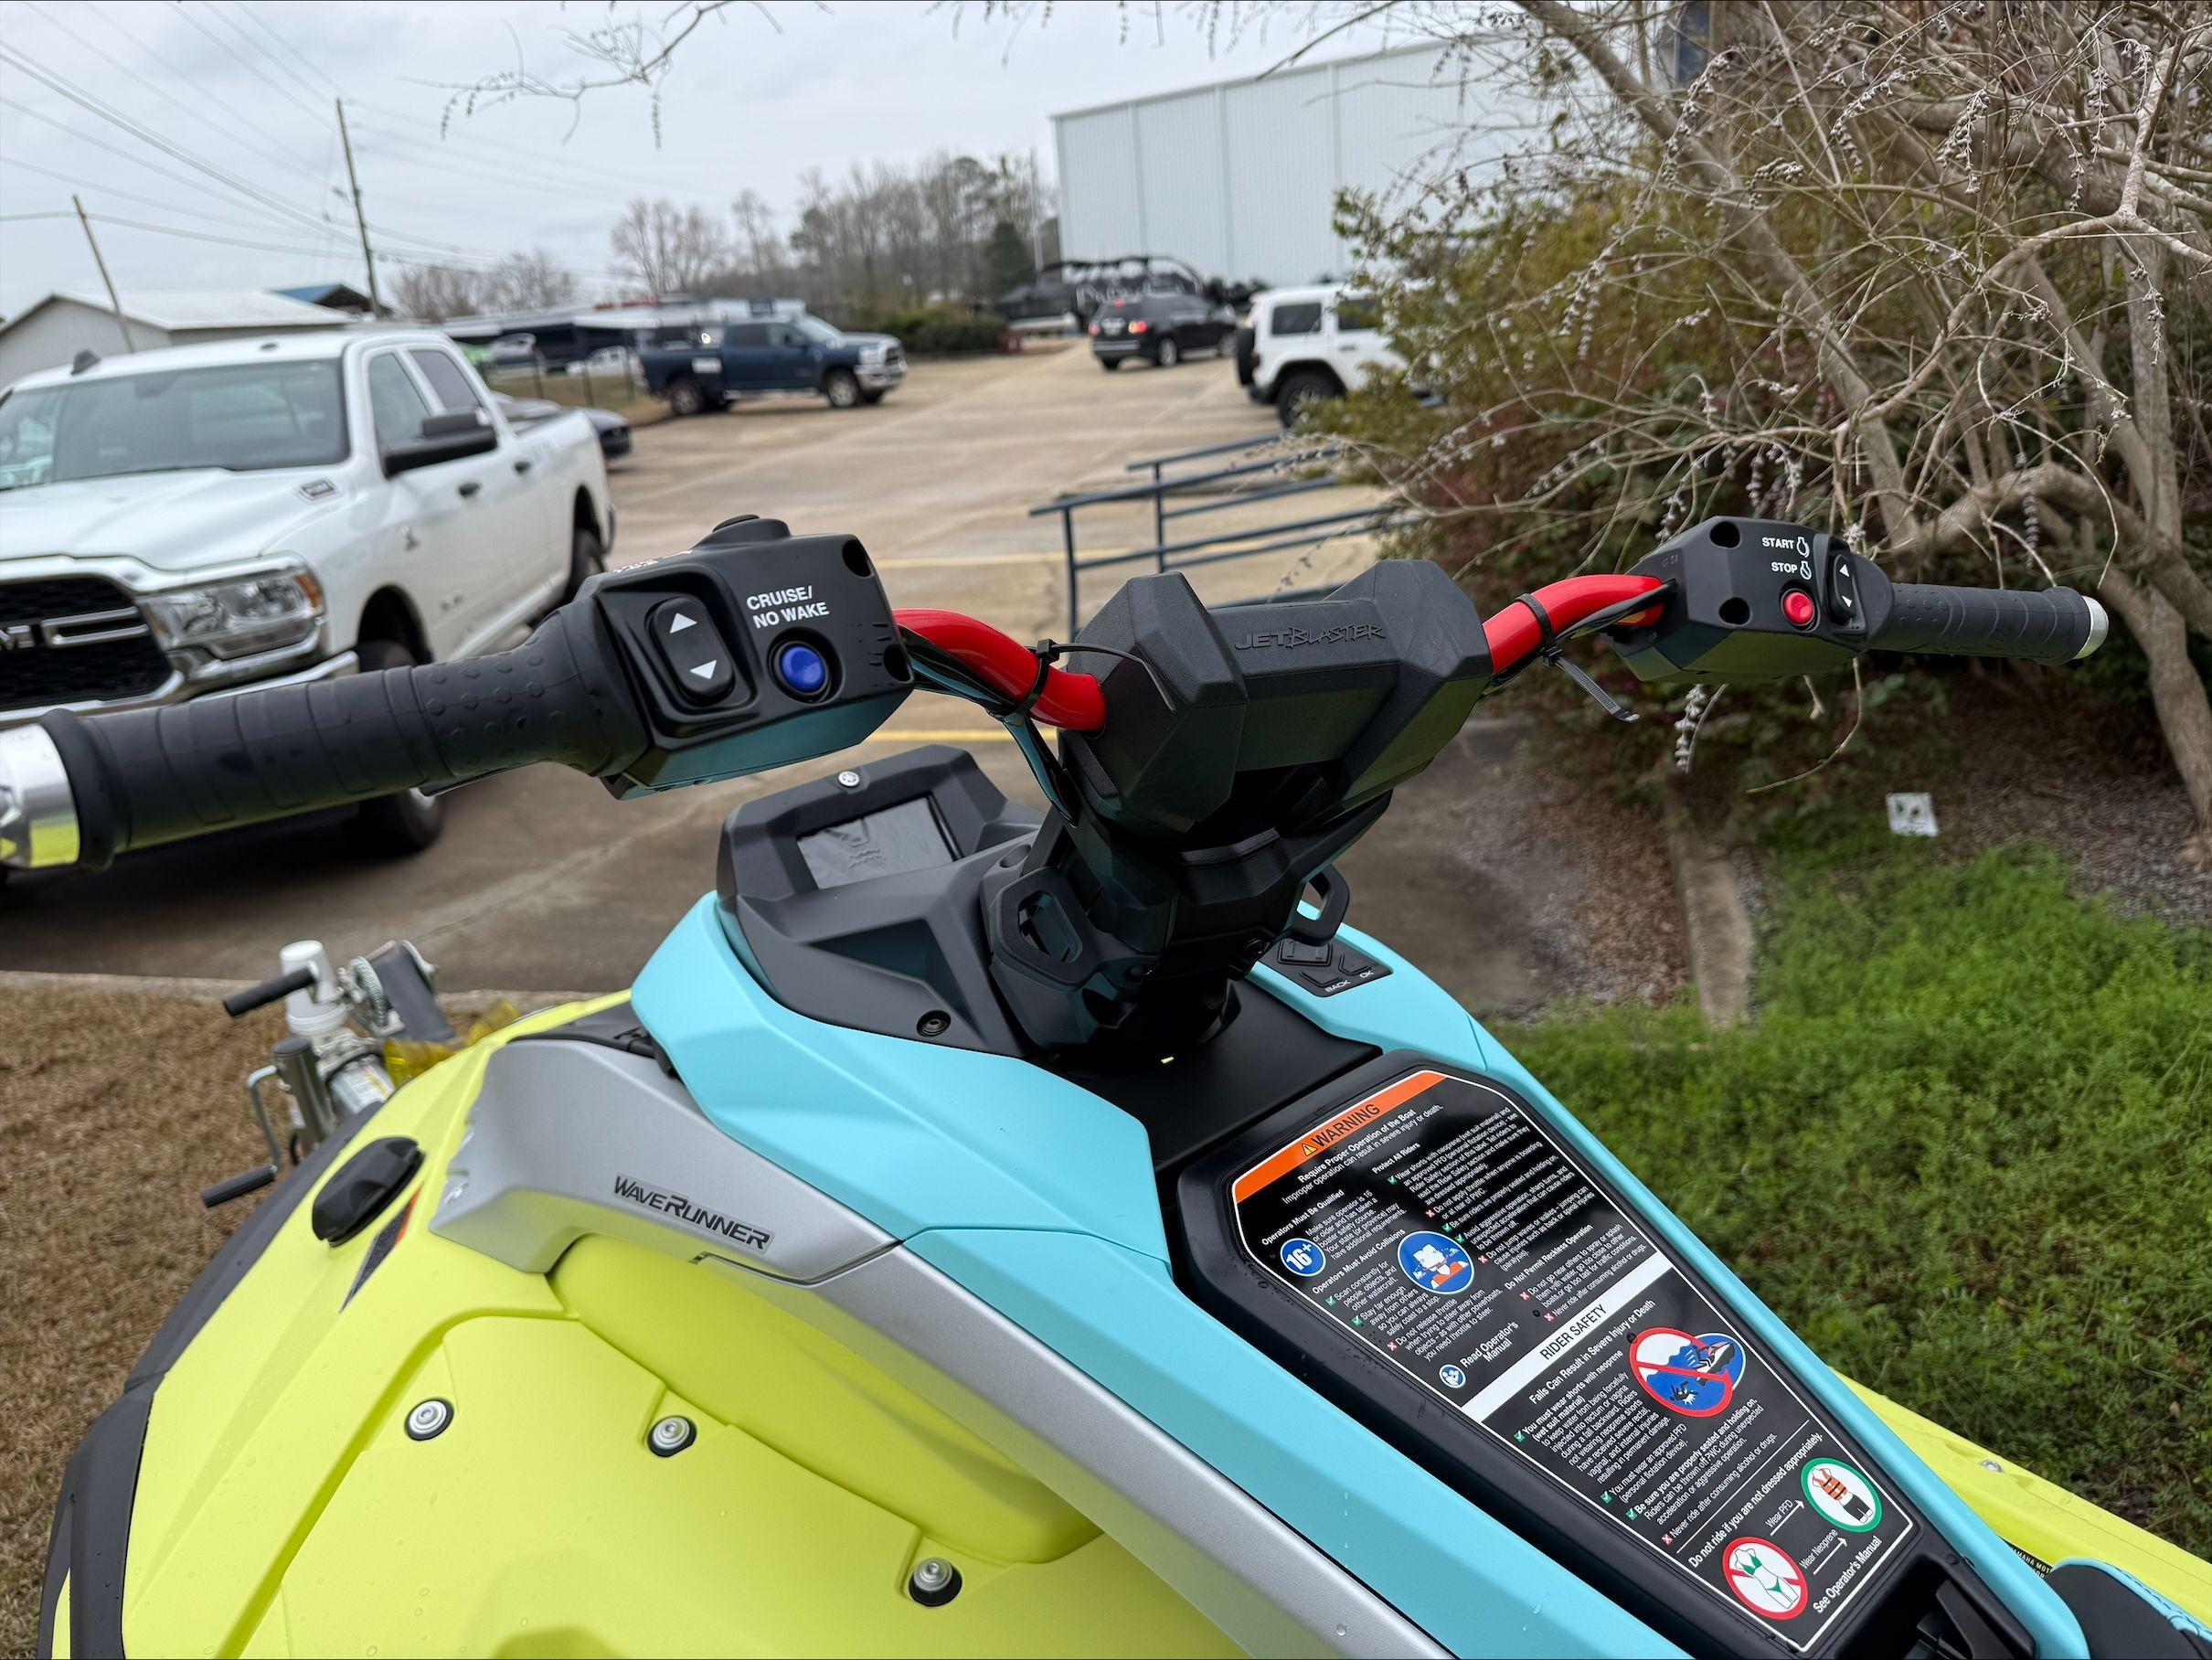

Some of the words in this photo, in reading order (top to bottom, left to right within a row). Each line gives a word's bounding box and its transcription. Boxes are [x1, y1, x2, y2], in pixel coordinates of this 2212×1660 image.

[1762, 537, 1794, 550] START
[1771, 562, 1797, 574] STOP
[746, 585, 813, 611] CRUISE/
[752, 611, 780, 629] NO
[781, 602, 830, 623] WAKE
[1324, 979, 1351, 993] BACK
[1359, 970, 1374, 979] OK
[1297, 1164, 1326, 1182] Require
[1324, 1148, 1349, 1165] Proper
[1347, 1130, 1382, 1151] Operation
[1380, 1123, 1389, 1132] of
[1387, 1119, 1400, 1128] the
[1397, 1109, 1416, 1121] Boat
[1310, 1103, 1380, 1146] WARNING
[1281, 1182, 1313, 1204] Improper
[1313, 1163, 1345, 1185] operation
[1343, 1155, 1357, 1165] can
[1355, 1144, 1374, 1158] result
[1379, 1129, 1400, 1144] severe
[1398, 1119, 1418, 1131] injury
[1422, 1104, 1443, 1117] death.
[1371, 1157, 1395, 1174] Protect
[1392, 1152, 1402, 1161] All
[1399, 1143, 1420, 1155] Riders
[1261, 1222, 1293, 1245] Operators
[1291, 1211, 1310, 1225] Must
[1306, 1207, 1318, 1215] Be
[1316, 1188, 1344, 1208] Qualified
[1304, 1223, 1324, 1236] Make
[1322, 1214, 1335, 1225] sure
[1335, 1199, 1358, 1218] operator
[1317, 1232, 1338, 1248] boater
[1336, 1221, 1356, 1235] safety
[1319, 1225, 1335, 1237] older
[1334, 1216, 1346, 1228] and
[1344, 1210, 1357, 1220] has
[1355, 1200, 1373, 1213] taken
[1323, 1242, 1339, 1253] Your
[1338, 1232, 1354, 1244] state
[1385, 1202, 1399, 1213] may
[1312, 1270, 1345, 1293] Operators
[1342, 1259, 1360, 1272] Must
[1358, 1246, 1377, 1262] Avoid
[1375, 1229, 1405, 1250] Collisions
[1330, 1248, 1346, 1260] have
[1345, 1229, 1372, 1250] additional
[1504, 1281, 1515, 1290] Do
[1512, 1272, 1526, 1282] Not
[1523, 1259, 1545, 1275] Permit
[1540, 1241, 1568, 1261] Reckless
[1565, 1224, 1593, 1244] Operation
[1333, 1287, 1351, 1300] Scan
[1350, 1266, 1380, 1289] constantly
[1377, 1261, 1388, 1269] for
[1384, 1264, 1397, 1276] and
[1351, 1297, 1367, 1310] other
[1459, 1347, 1483, 1367] Read
[1479, 1321, 1518, 1351] Operator's
[1482, 1336, 1512, 1361] Manual
[1528, 1387, 1548, 1404] Falls
[1546, 1376, 1563, 1389] Can
[1558, 1357, 1584, 1378] Result
[1579, 1353, 1591, 1361] in
[1587, 1335, 1612, 1355] Severe
[1608, 1320, 1631, 1337] Injury
[1627, 1314, 1637, 1323] or
[1632, 1300, 1655, 1317] Death
[1539, 1332, 1573, 1359] RIDER
[1569, 1304, 1606, 1335] SAFETY
[1521, 1422, 1537, 1434] You
[1536, 1409, 1553, 1424] must
[1550, 1397, 1567, 1411] wear
[1565, 1381, 1586, 1399] shorts
[1583, 1371, 1598, 1383] with
[1595, 1350, 1622, 1374] neoprene
[1540, 1438, 1550, 1446] to
[1547, 1427, 1564, 1441] keep
[1561, 1413, 1579, 1429] water
[1575, 1403, 1591, 1416] from
[1587, 1390, 1607, 1406] being
[1601, 1371, 1628, 1393] forcefully
[1531, 1426, 1548, 1442] (wet
[1546, 1416, 1560, 1429] suit
[1558, 1394, 1585, 1420] material)
[1549, 1429, 1575, 1452] injected
[1571, 1421, 1586, 1433] into
[1584, 1405, 1604, 1423] rectum
[1602, 1399, 1611, 1407] or
[1608, 1384, 1628, 1401] vagina
[1608, 1483, 1623, 1495] You
[1621, 1470, 1636, 1486] must
[1633, 1459, 1648, 1474] wear
[1645, 1453, 1655, 1463] an
[1652, 1432, 1676, 1456] approved
[1672, 1423, 1686, 1436] PFD
[1633, 1503, 1646, 1514] Be
[1643, 1490, 1659, 1505] sure
[1656, 1479, 1670, 1495] you
[1668, 1471, 1680, 1483] are
[1677, 1449, 1702, 1474] properly
[1699, 1431, 1719, 1452] seated
[1717, 1421, 1730, 1435] and
[1726, 1405, 1749, 1425] holding
[1746, 1398, 1757, 1408] on.
[1619, 1474, 1646, 1503] (personal
[1643, 1456, 1668, 1479] flotation
[1656, 1491, 1690, 1525] acceleration
[1687, 1484, 1696, 1494] or
[1694, 1459, 1723, 1487] aggressive
[1720, 1437, 1747, 1462] operation.
[1668, 1518, 1688, 1538] Never
[1686, 1508, 1700, 1522] ride
[1697, 1495, 1711, 1511] after
[1709, 1470, 1740, 1498] consuming
[1736, 1451, 1756, 1473] alcohol
[1753, 1446, 1761, 1454] or
[1760, 1432, 1777, 1449] drugs.
[1687, 1554, 1703, 1567] Do
[1699, 1540, 1715, 1557] not
[1711, 1529, 1727, 1545] ride
[1721, 1522, 1732, 1532] if
[1728, 1512, 1744, 1529] you
[1740, 1502, 1753, 1515] are
[1750, 1489, 1764, 1505] not
[1760, 1466, 1787, 1494] dressed
[1783, 1431, 1823, 1471] appropriately.
[1764, 1511, 1781, 1527] Wear
[1778, 1499, 1792, 1514] PFD
[1799, 1552, 1815, 1569] Wear
[1811, 1528, 1837, 1556] Neoprene
[1813, 1596, 1830, 1612] See
[1825, 1560, 1860, 1598] Operator's
[1855, 1535, 1882, 1564] Manual
